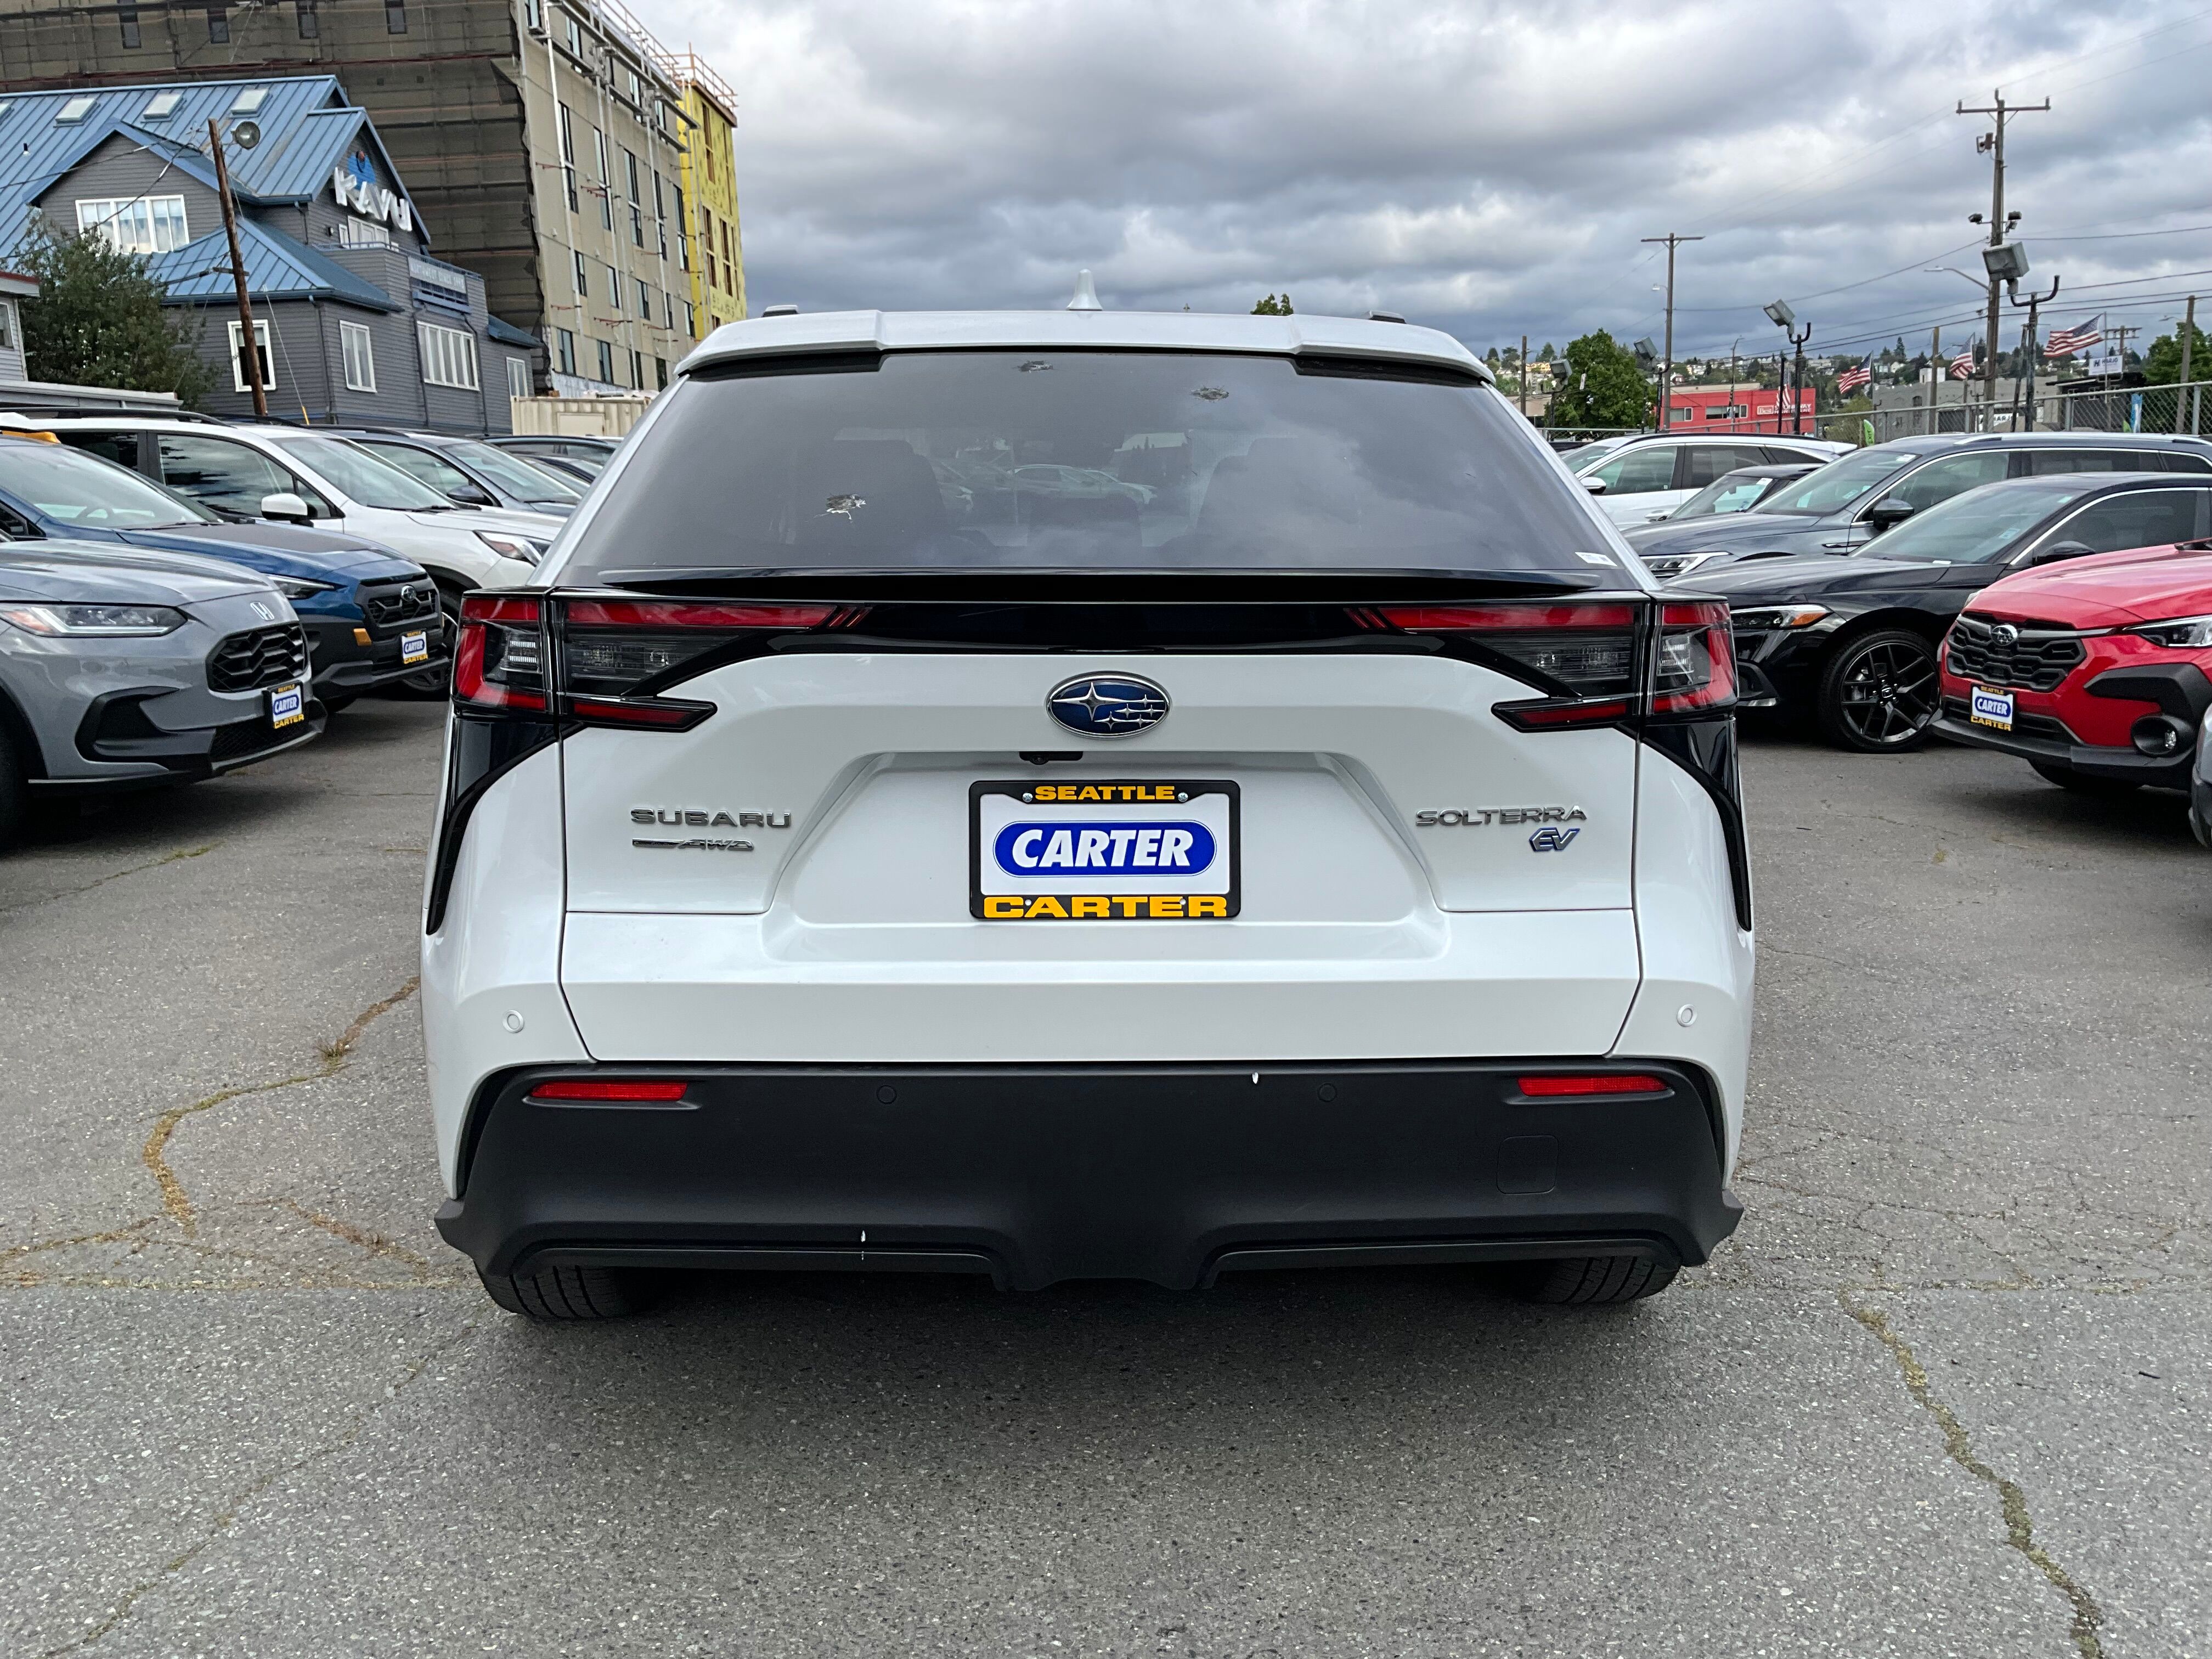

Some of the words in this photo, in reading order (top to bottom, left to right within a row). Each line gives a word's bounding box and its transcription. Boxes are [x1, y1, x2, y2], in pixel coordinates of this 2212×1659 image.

[334, 167, 412, 232] KAVU
[1980, 686, 2004, 695] SEATTLE
[275, 697, 297, 713] CARTER
[1977, 698, 2007, 715] CARTER
[274, 714, 304, 729] CARTER
[1971, 715, 2011, 731] CARTER
[1035, 786, 1175, 800] SEATTLE
[630, 808, 792, 828] SUBARU
[1415, 805, 1587, 827] SOLTERRA
[678, 838, 754, 850] AWD
[1529, 827, 1581, 851] EV
[1012, 829, 1194, 868] CARTER
[984, 896, 1227, 918] CARTER
